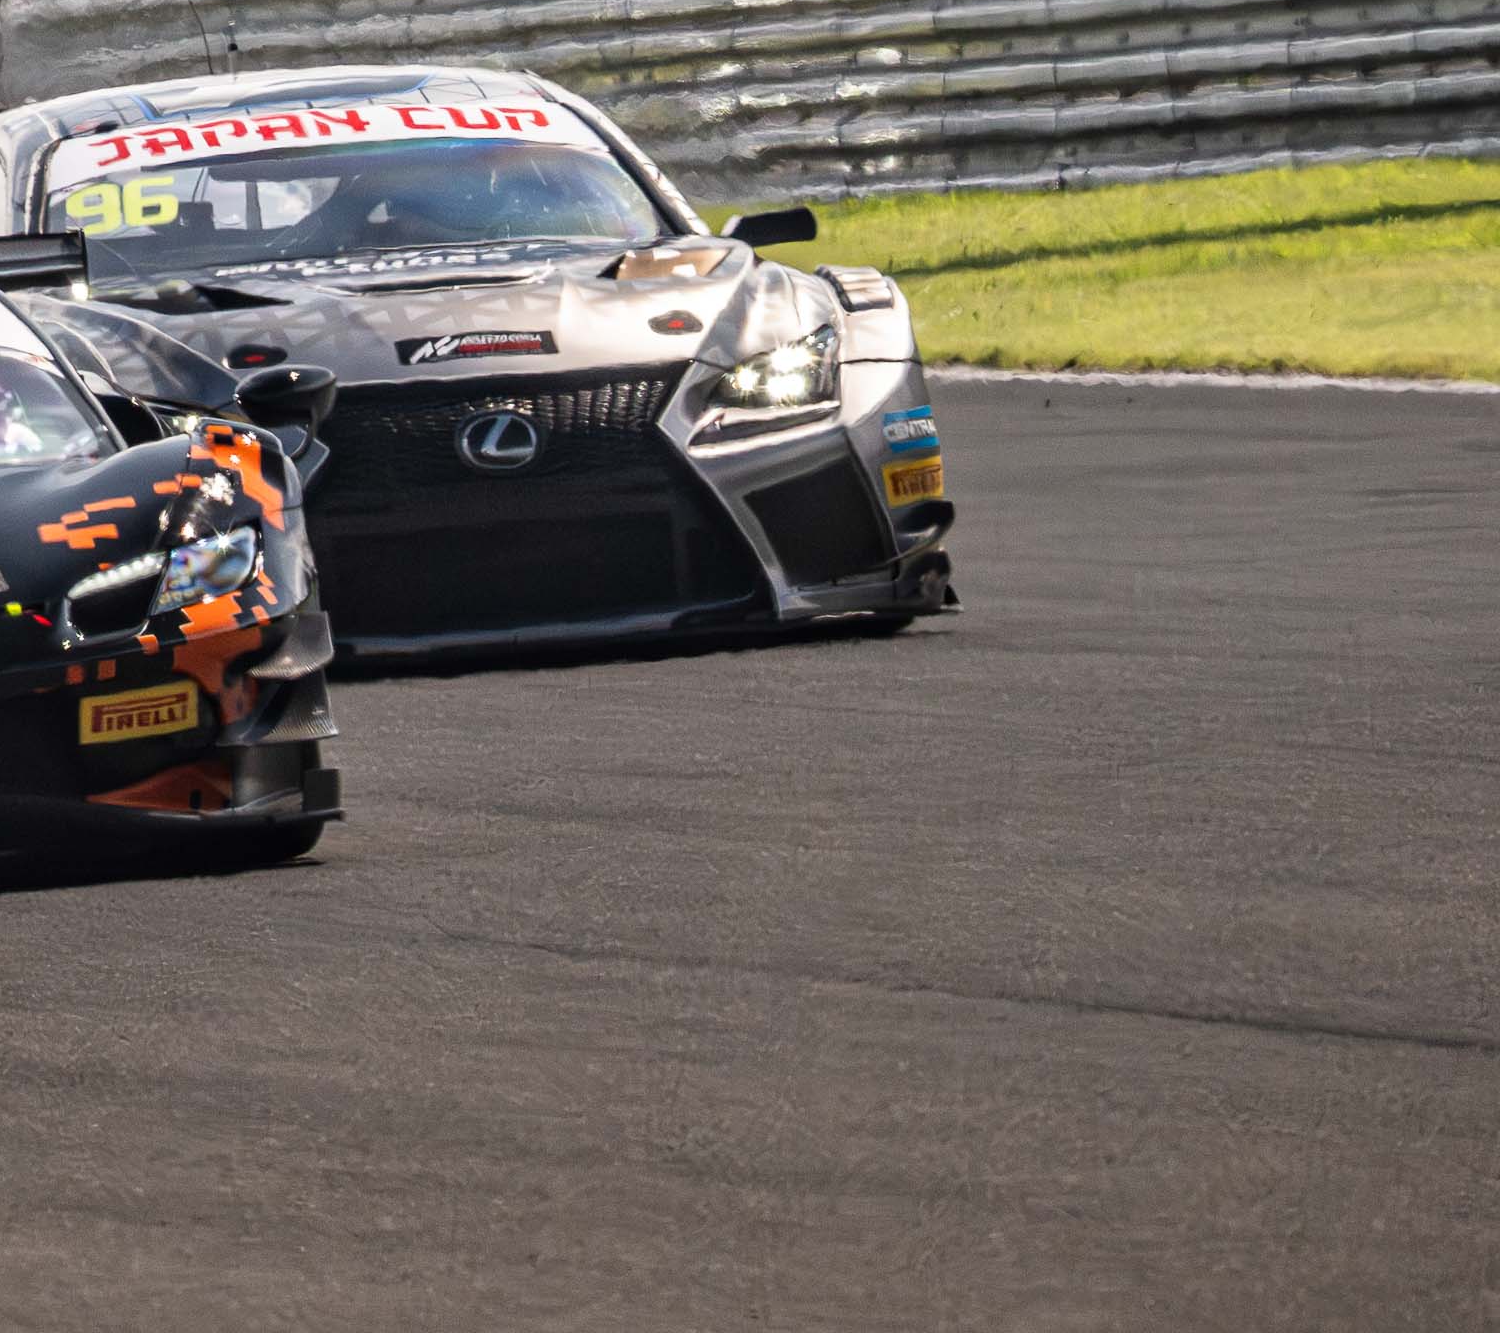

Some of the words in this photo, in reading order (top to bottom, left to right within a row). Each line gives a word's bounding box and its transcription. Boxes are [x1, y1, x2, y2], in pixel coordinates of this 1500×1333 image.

[87, 107, 370, 167] JAPAN
[389, 104, 550, 132] CUP
[65, 175, 179, 237] 96
[91, 691, 189, 733] PIRELLI
